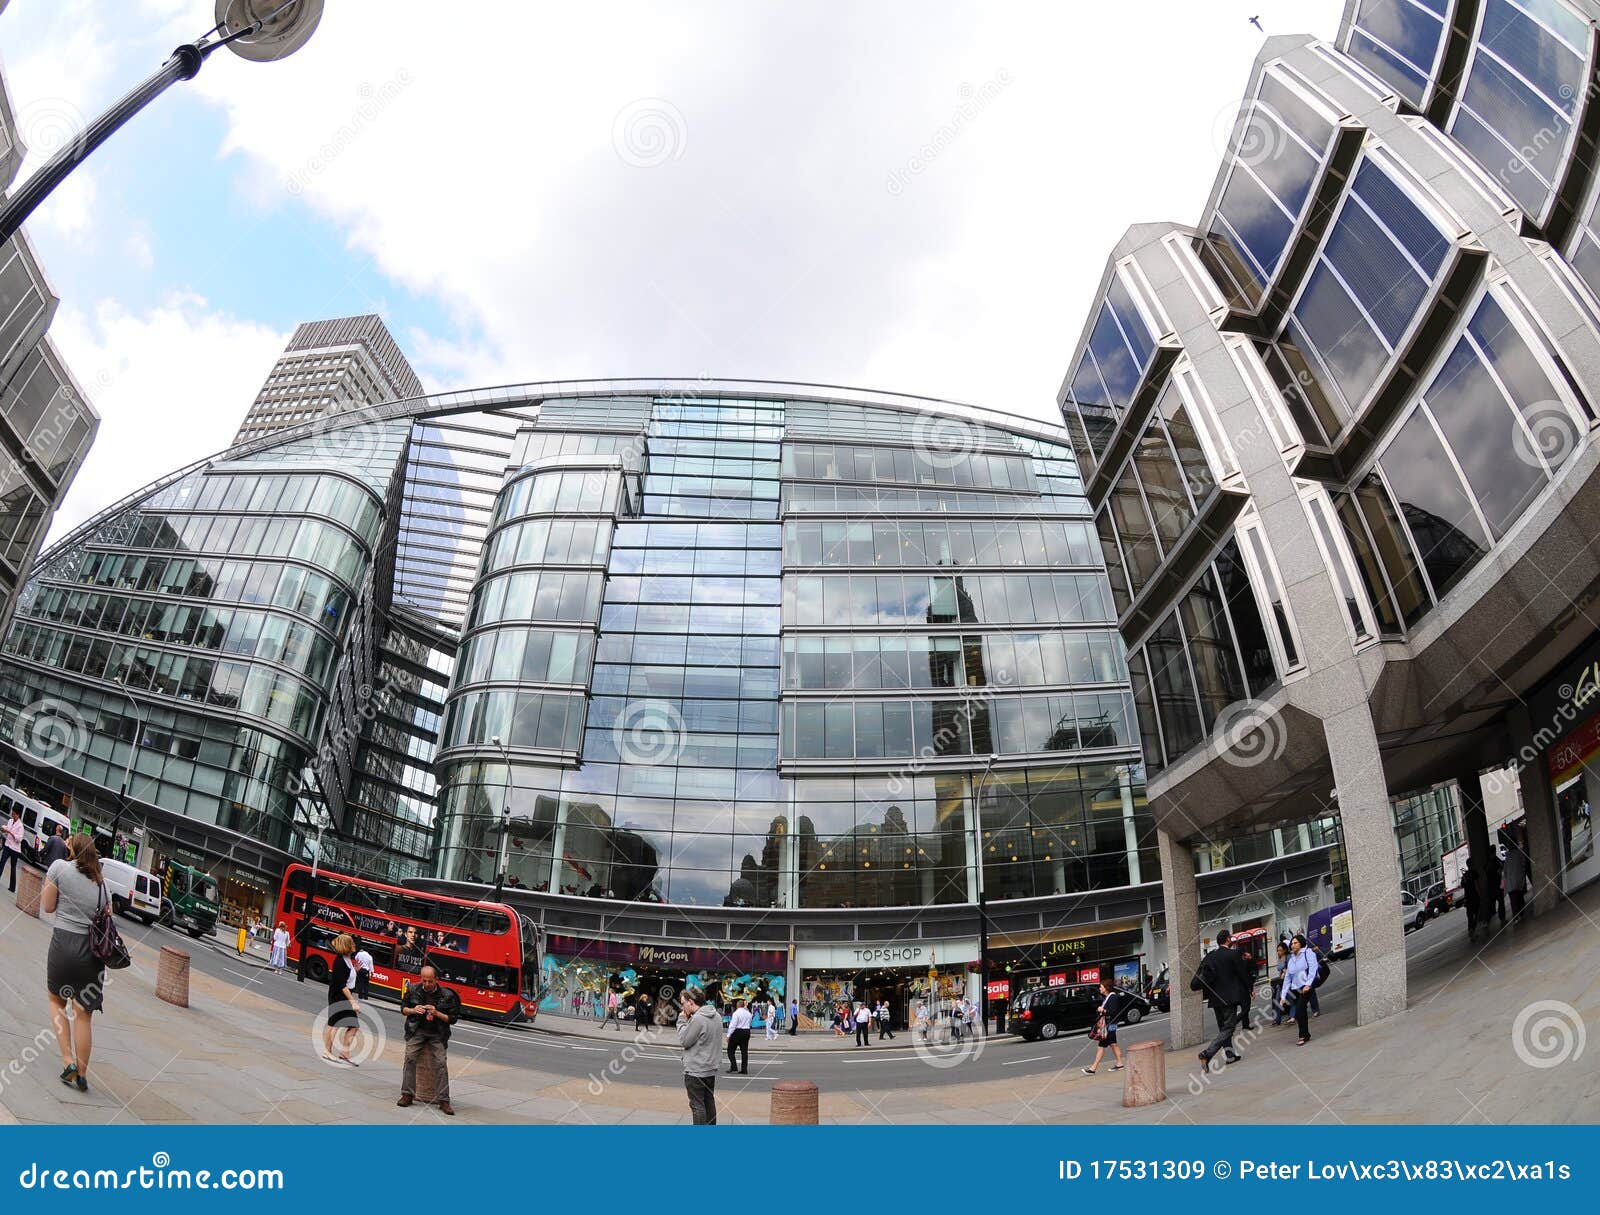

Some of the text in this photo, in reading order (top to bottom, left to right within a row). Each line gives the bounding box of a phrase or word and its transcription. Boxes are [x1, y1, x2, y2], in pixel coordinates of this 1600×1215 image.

[317, 905, 345, 921] eclipse
[638, 946, 689, 963] Monsoon
[853, 947, 922, 962] TOPSHOP
[987, 983, 1010, 994] sale
[1049, 976, 1065, 987] ale
